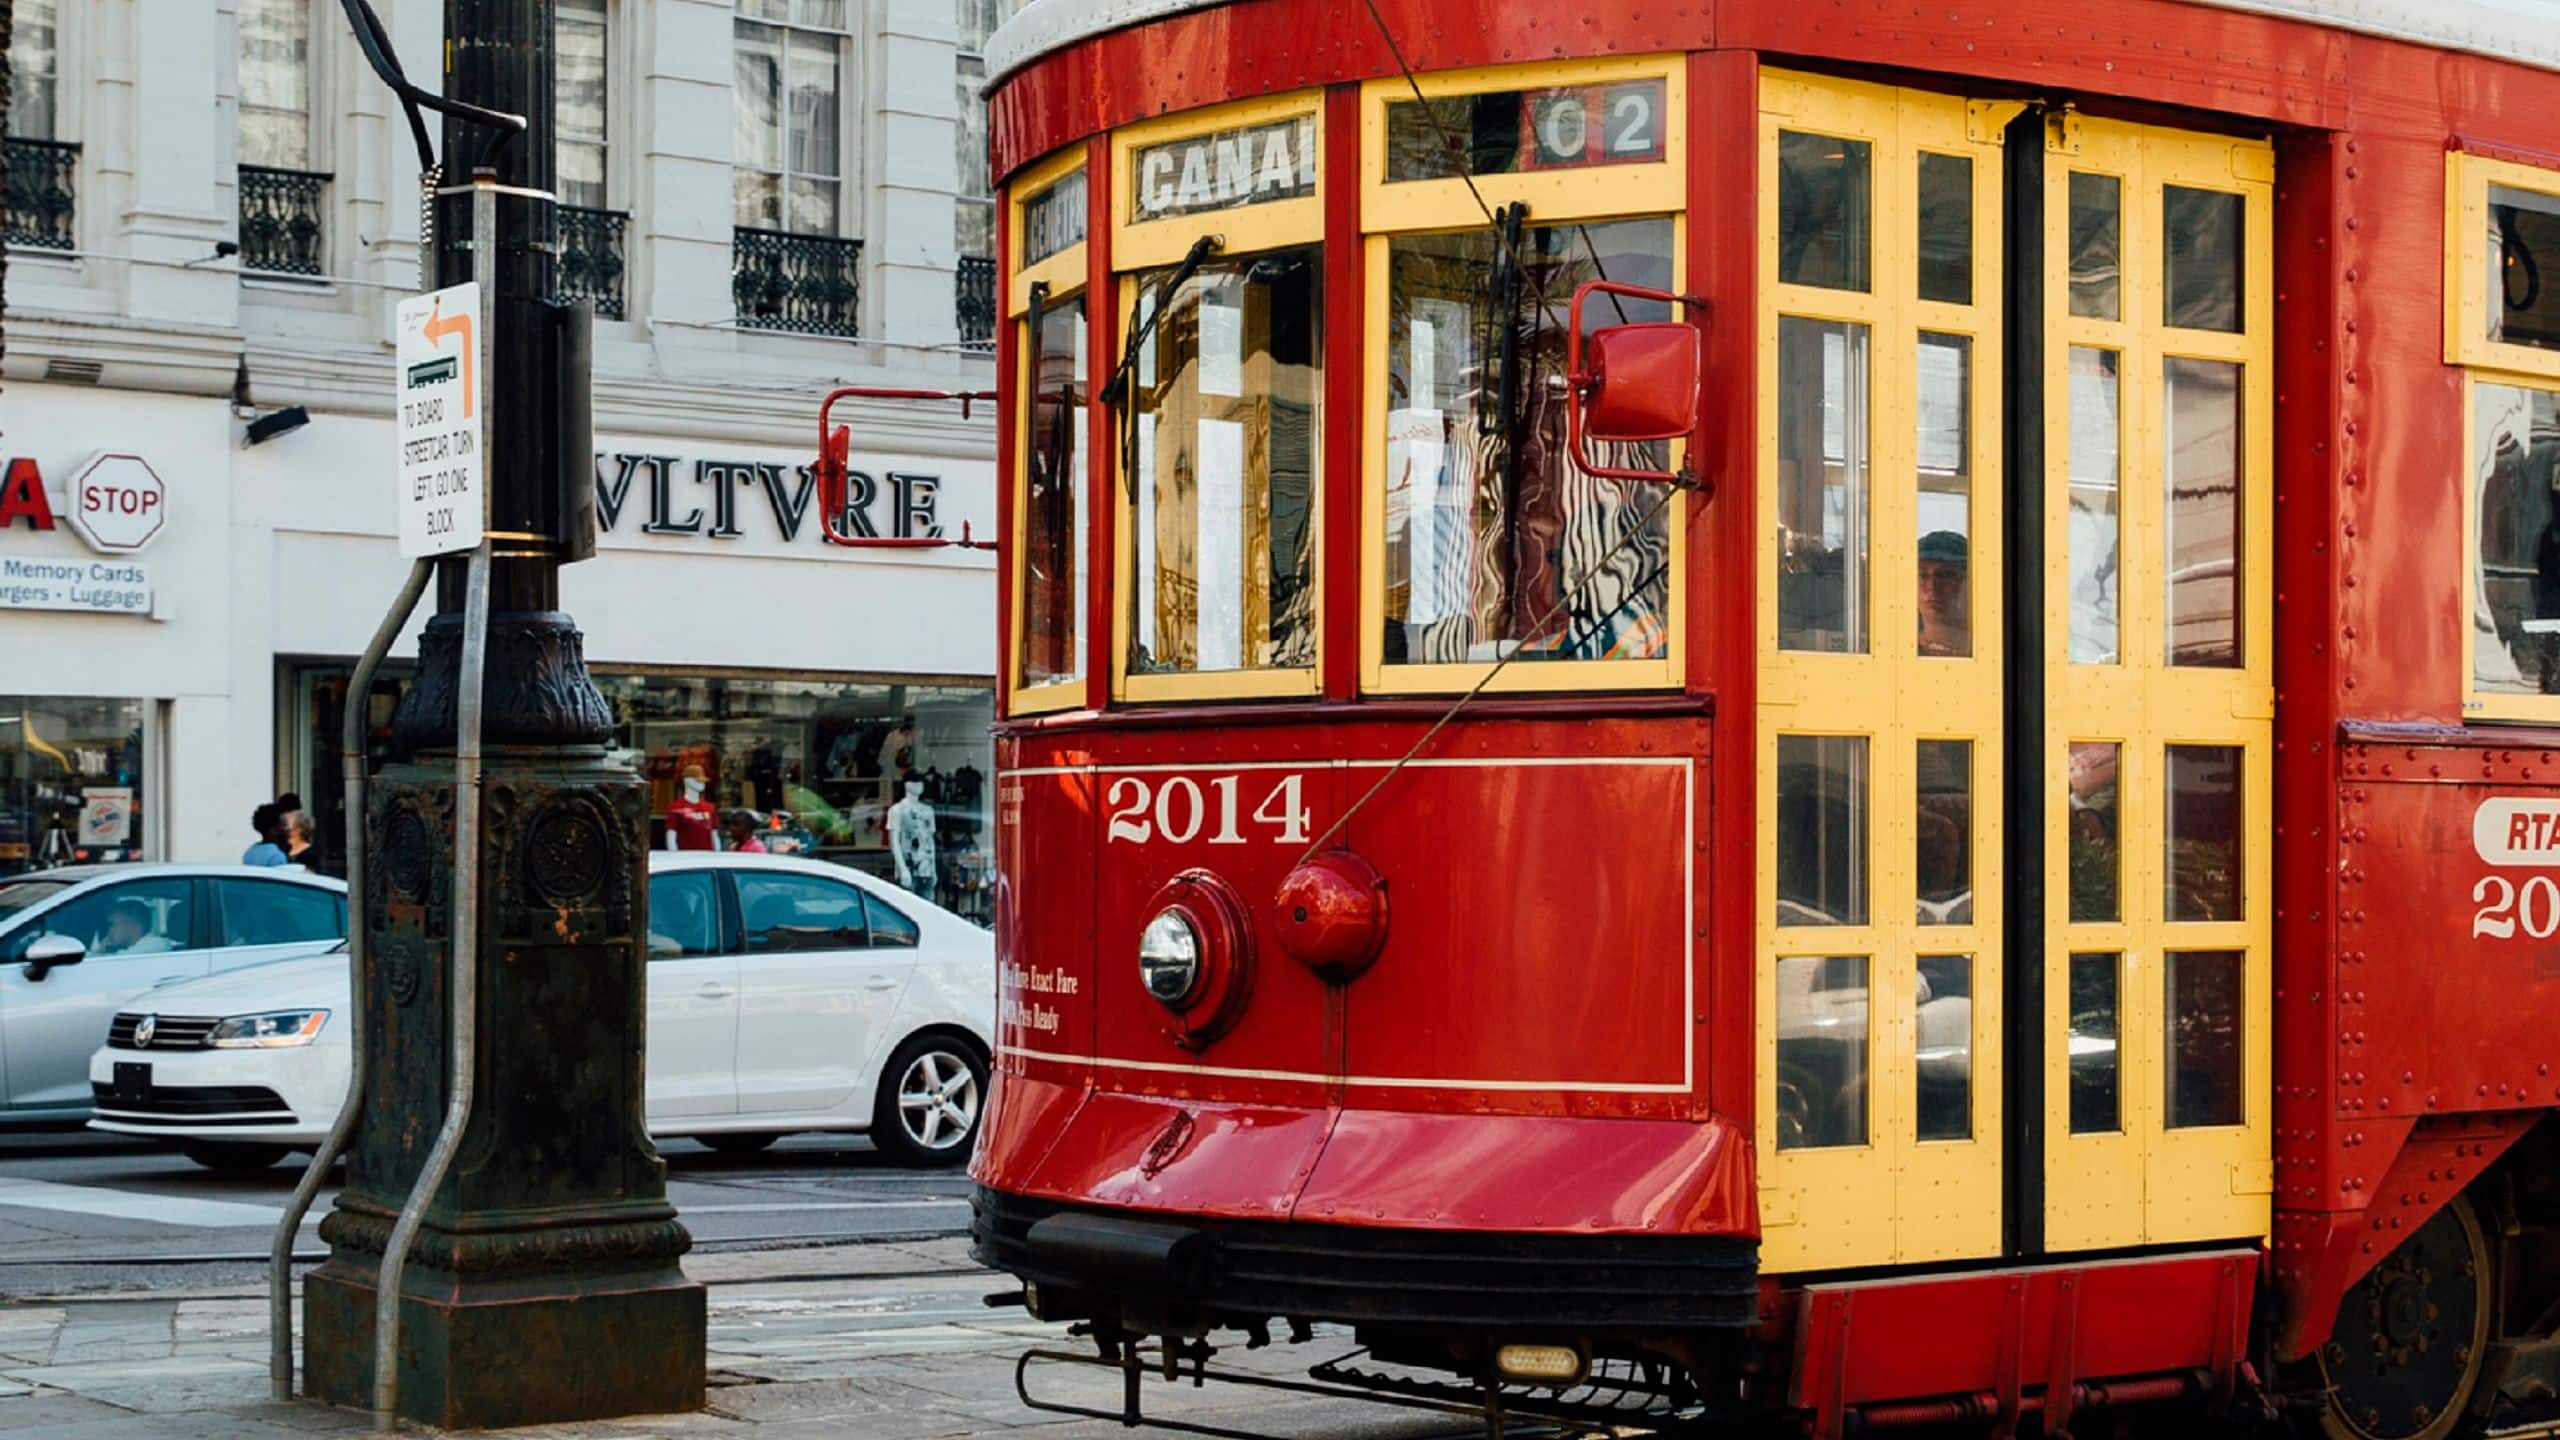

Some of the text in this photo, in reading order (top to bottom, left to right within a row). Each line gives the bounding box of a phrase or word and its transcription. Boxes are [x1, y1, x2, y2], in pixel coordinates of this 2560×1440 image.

[404, 397, 445, 429] TO BOARD
[404, 429, 474, 466] STREETCAR TURN
[436, 471, 449, 496] GO
[451, 467, 467, 493] ONE
[84, 485, 160, 516] STOP
[427, 507, 454, 535] BLOCK
[4, 559, 145, 584] Memory Cards
[70, 586, 145, 609] Luggage
[1107, 774, 1311, 844] 2014
[1030, 964, 1054, 993] Exact
[1056, 966, 1078, 995] Fare
[1033, 1002, 1060, 1036] Ready
